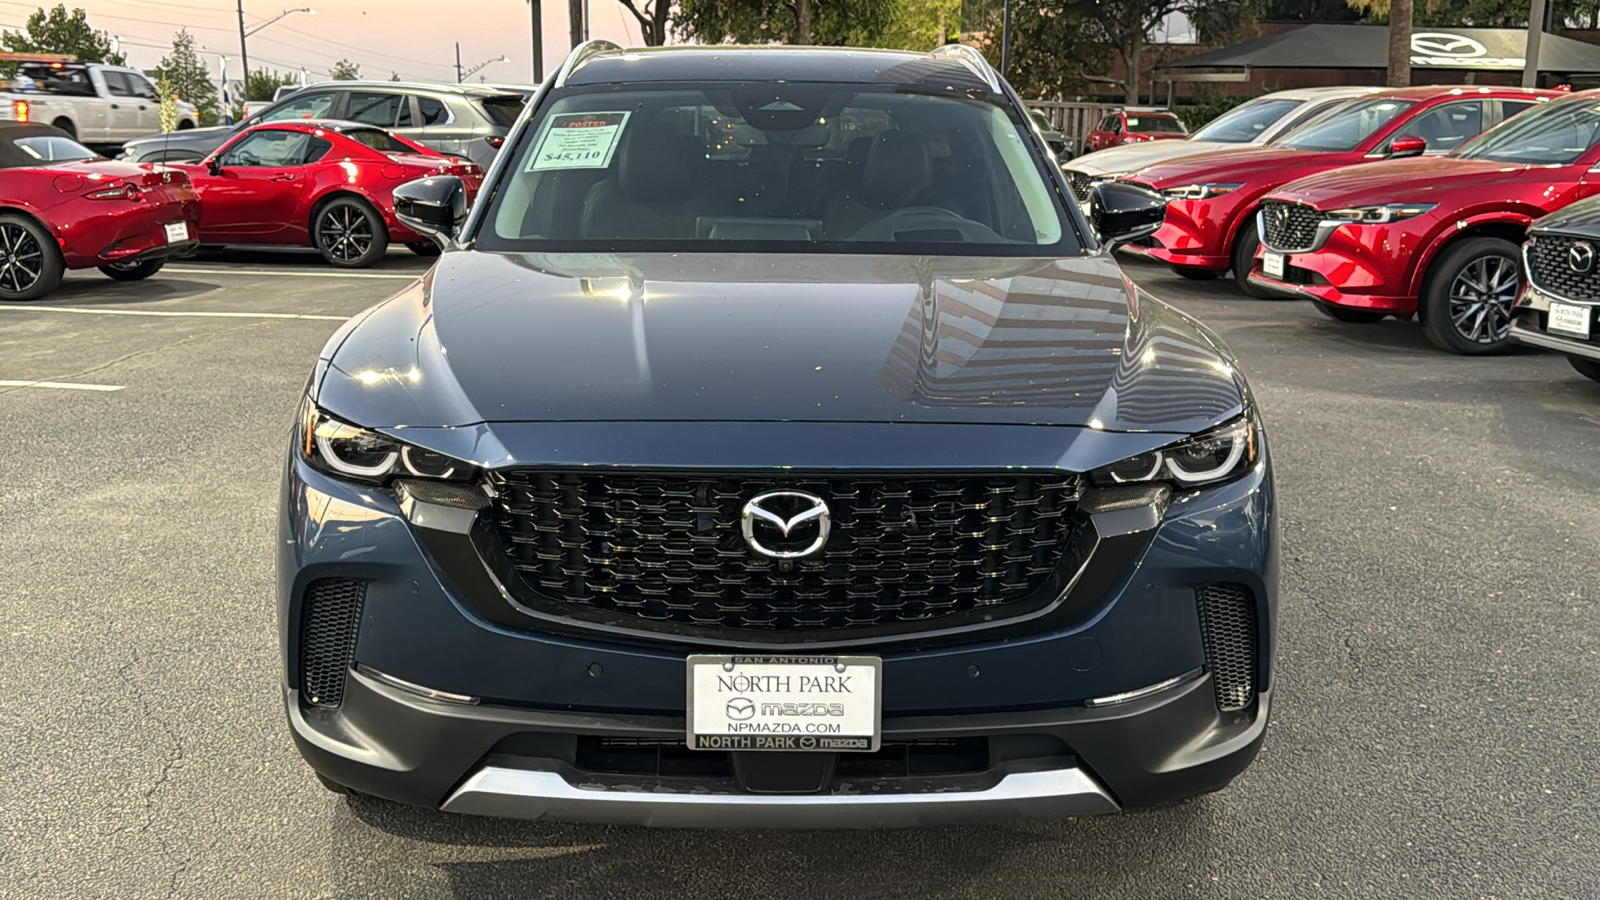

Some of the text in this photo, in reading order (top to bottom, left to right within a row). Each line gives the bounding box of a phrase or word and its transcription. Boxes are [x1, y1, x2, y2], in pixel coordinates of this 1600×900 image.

[544, 151, 600, 161] $45,110
[717, 674, 852, 693] NORTH PARK
[761, 702, 844, 716] mazda
[728, 723, 840, 733] NPMAZDA.COM
[700, 736, 868, 748] NORTH PARK mazda
